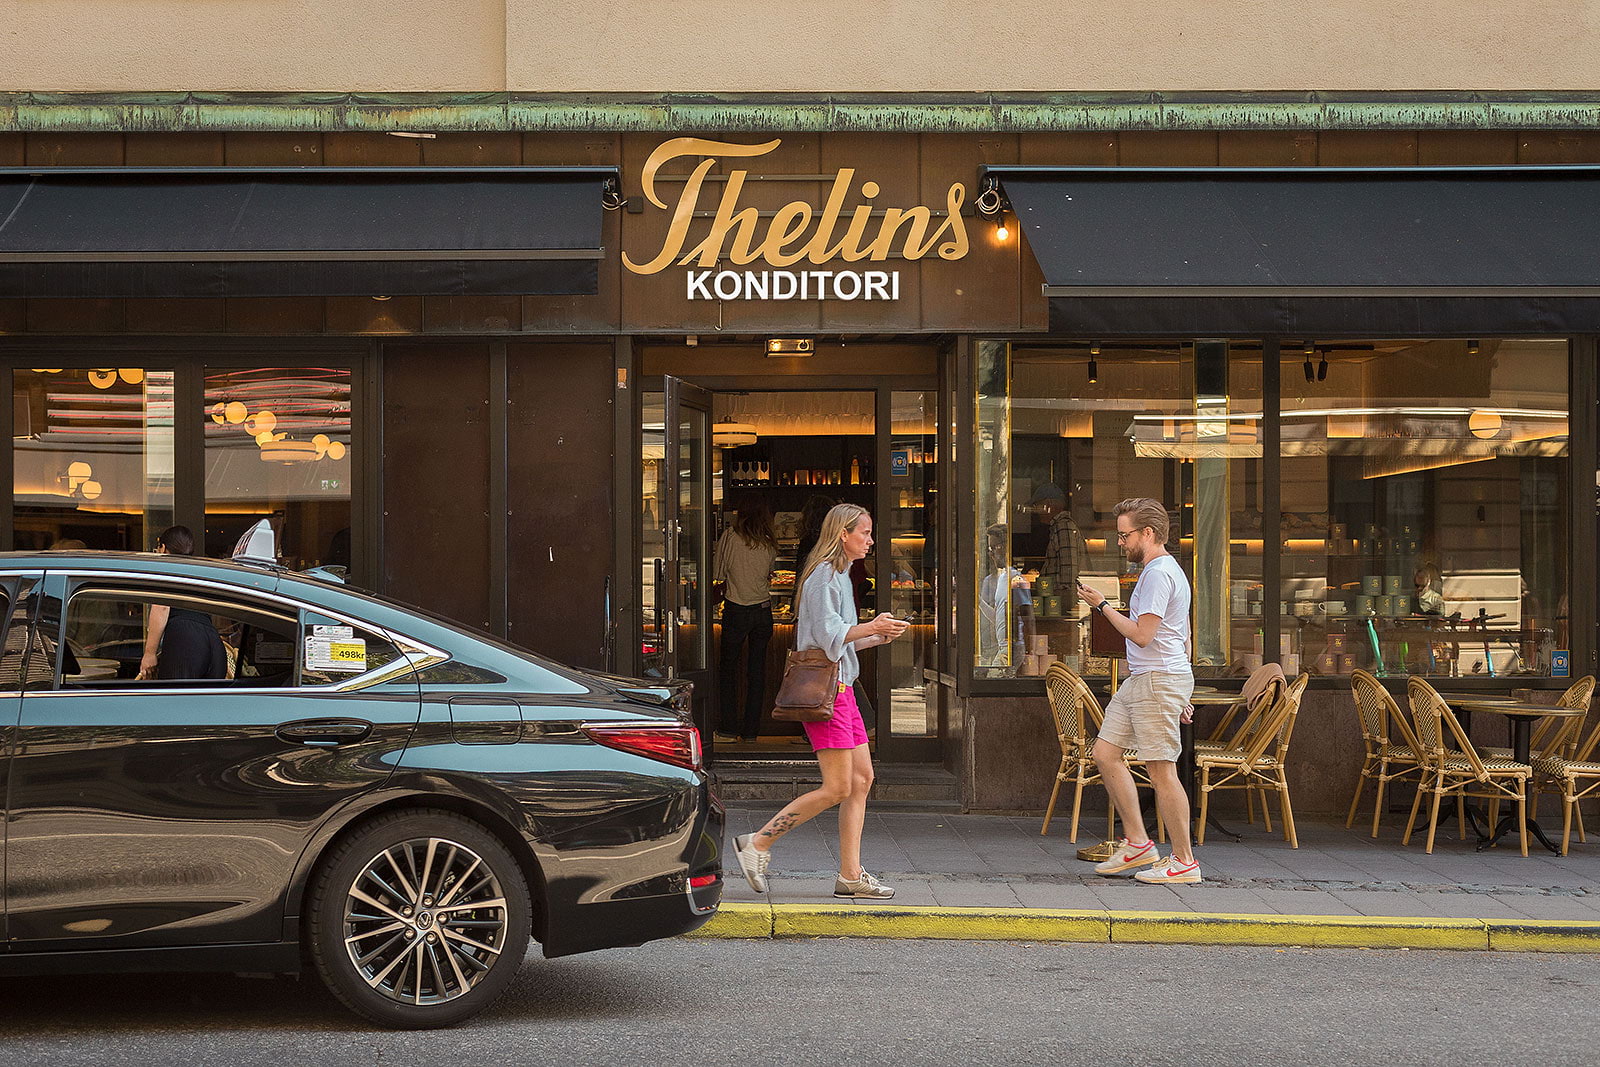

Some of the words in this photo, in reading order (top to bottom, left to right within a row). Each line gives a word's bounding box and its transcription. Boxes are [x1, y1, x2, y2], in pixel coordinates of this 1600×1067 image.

[621, 137, 970, 275] Thelins
[687, 271, 899, 300] KONDITORI
[338, 650, 365, 659] 498kr
